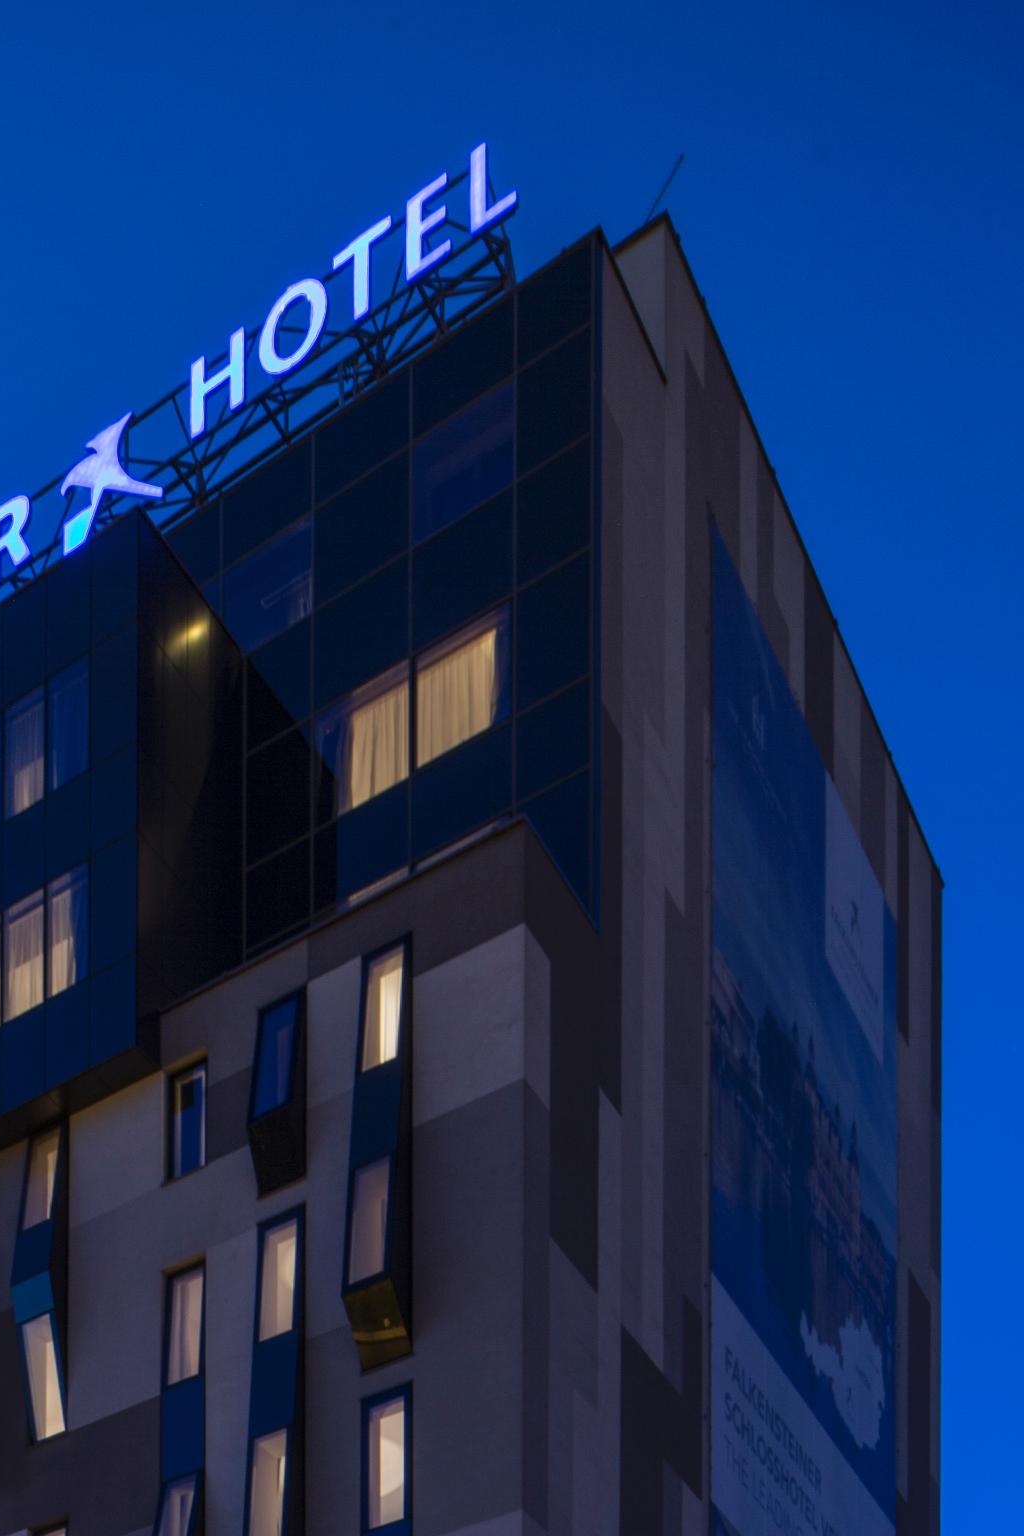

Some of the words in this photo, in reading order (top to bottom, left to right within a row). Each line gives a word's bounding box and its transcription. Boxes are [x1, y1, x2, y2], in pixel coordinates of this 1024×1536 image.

[188, 142, 517, 439] HOTEL
[725, 1345, 822, 1495] FALKENSTEINER
[725, 1391, 818, 1531] SCHLOSSHOTEL
